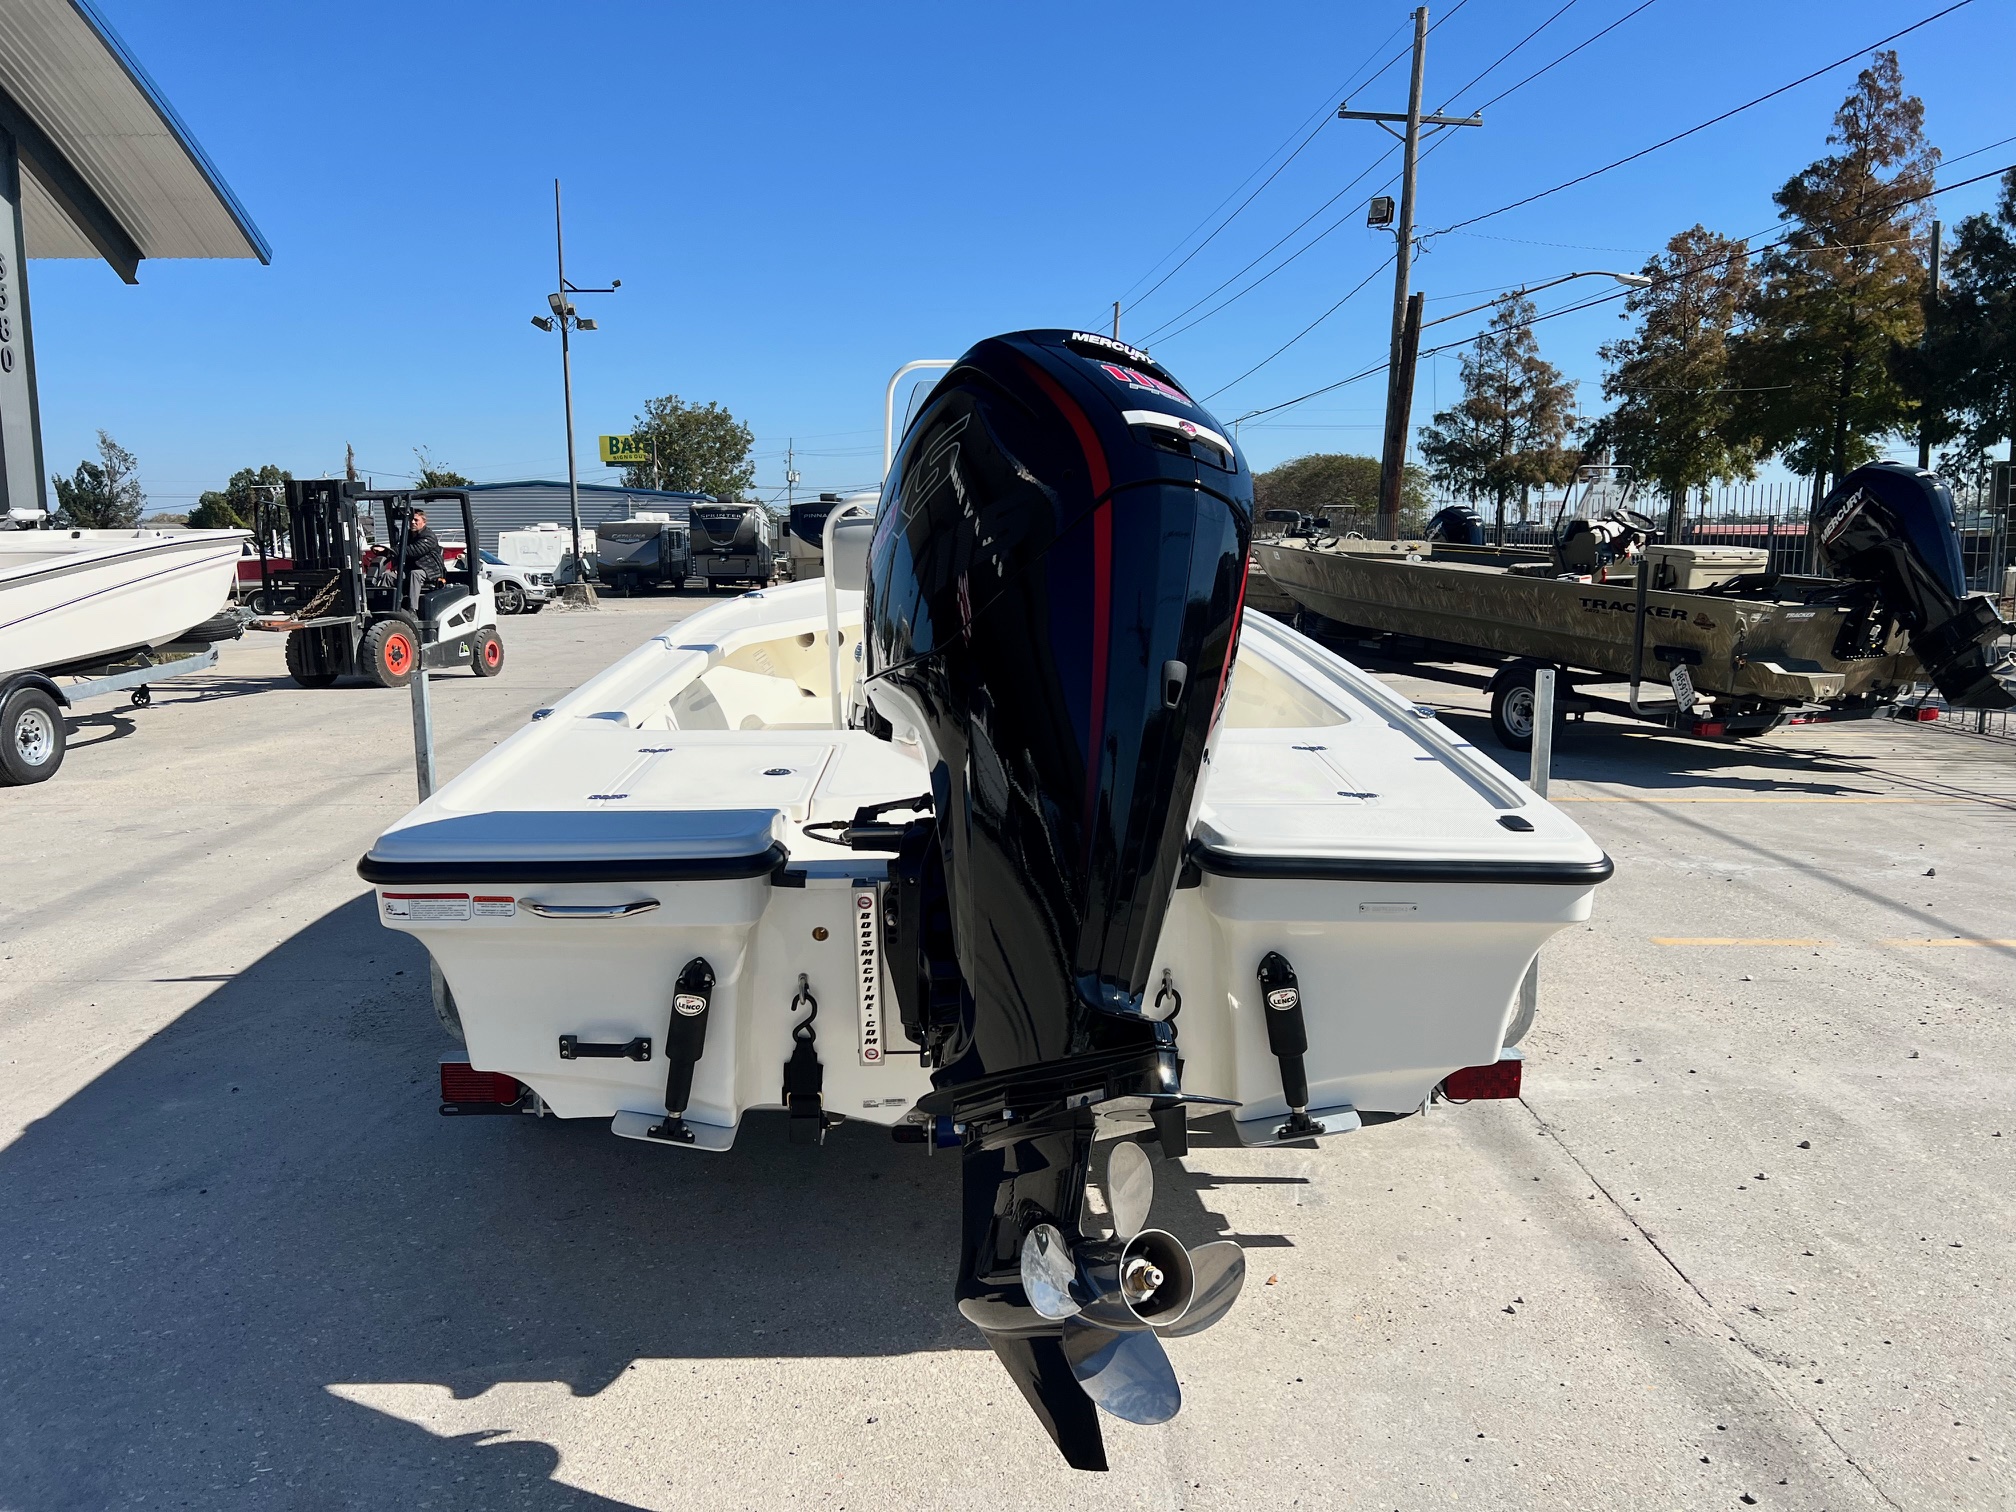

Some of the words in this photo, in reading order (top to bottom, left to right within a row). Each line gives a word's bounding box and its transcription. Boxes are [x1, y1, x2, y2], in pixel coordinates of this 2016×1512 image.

[1072, 332, 1156, 364] MERCURY
[1820, 486, 1864, 544] MERCURY
[1579, 598, 1688, 621] TRACKER
[678, 1002, 701, 1010] LENCO
[1273, 996, 1295, 1005] LENCO
